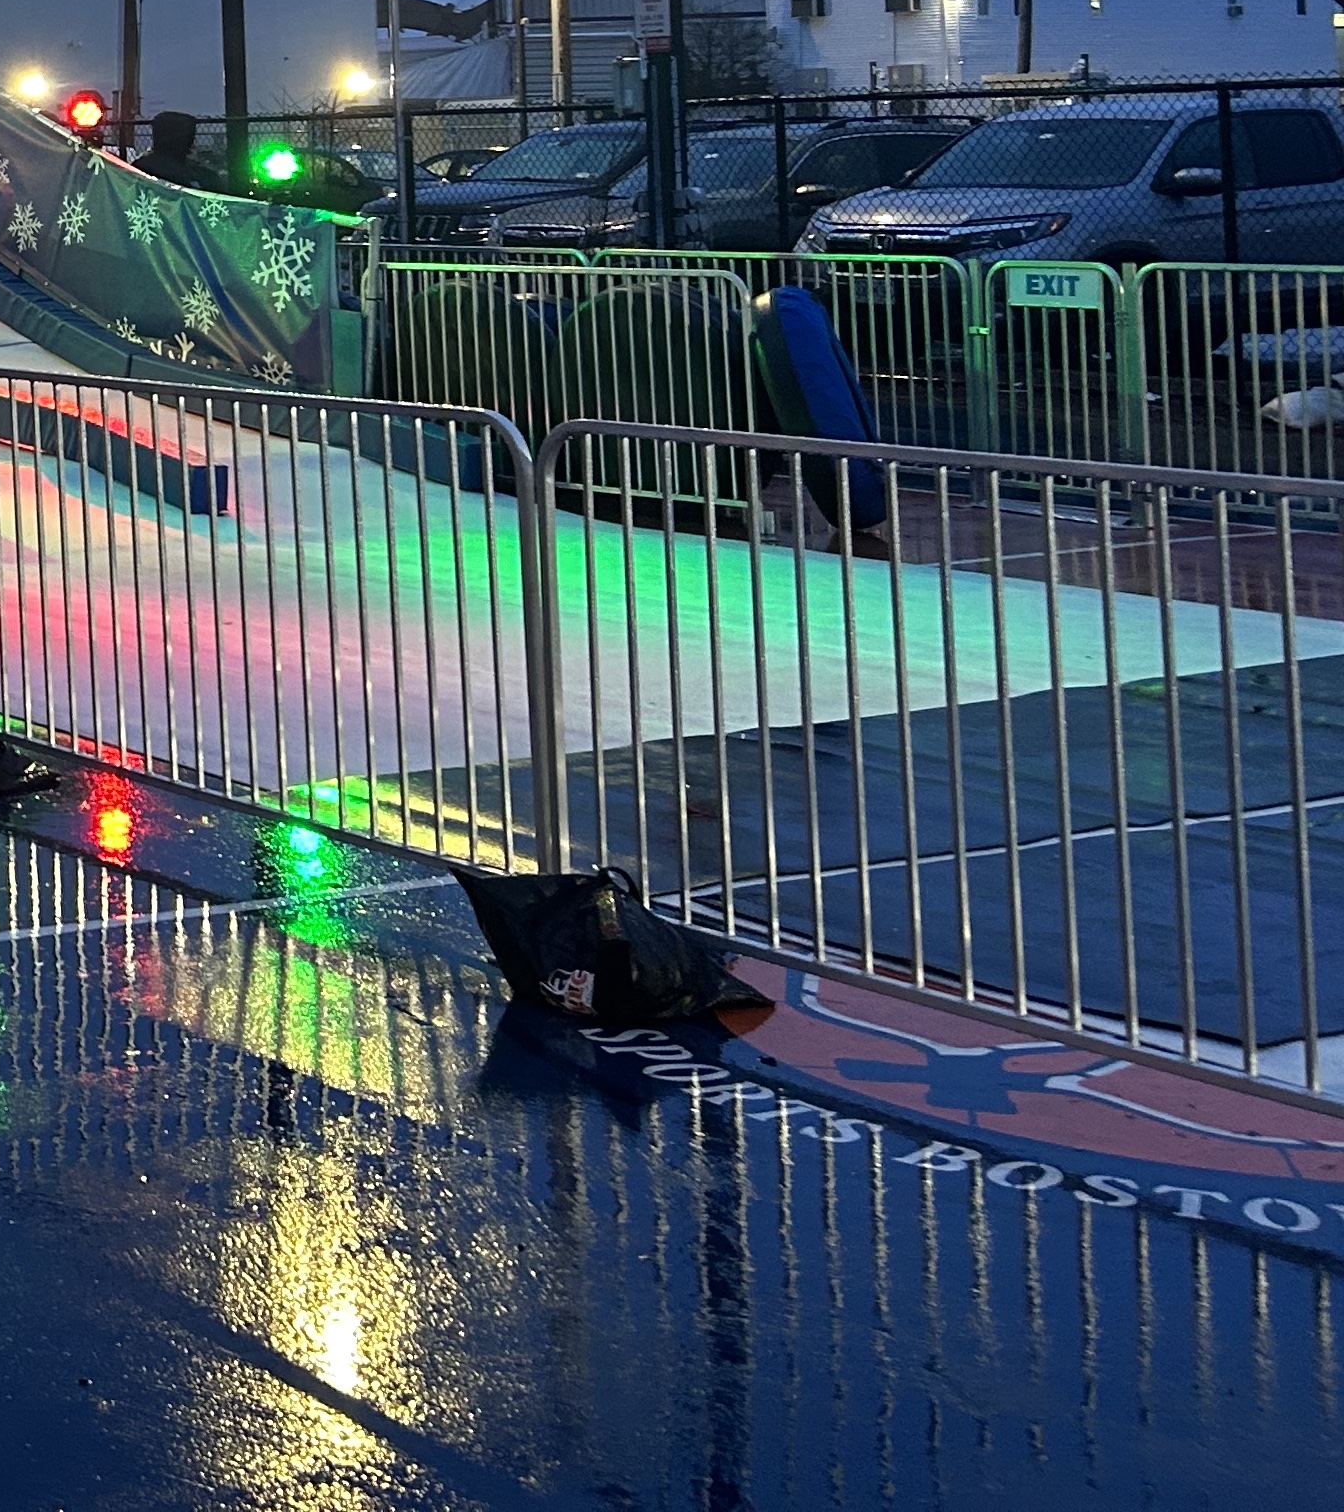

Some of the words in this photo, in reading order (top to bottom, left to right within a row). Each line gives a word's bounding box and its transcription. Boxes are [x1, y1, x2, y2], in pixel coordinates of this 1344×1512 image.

[1026, 274, 1080, 296] EXIT
[578, 1028, 883, 1142] SPORTS
[893, 1141, 1344, 1233] BOSTO
